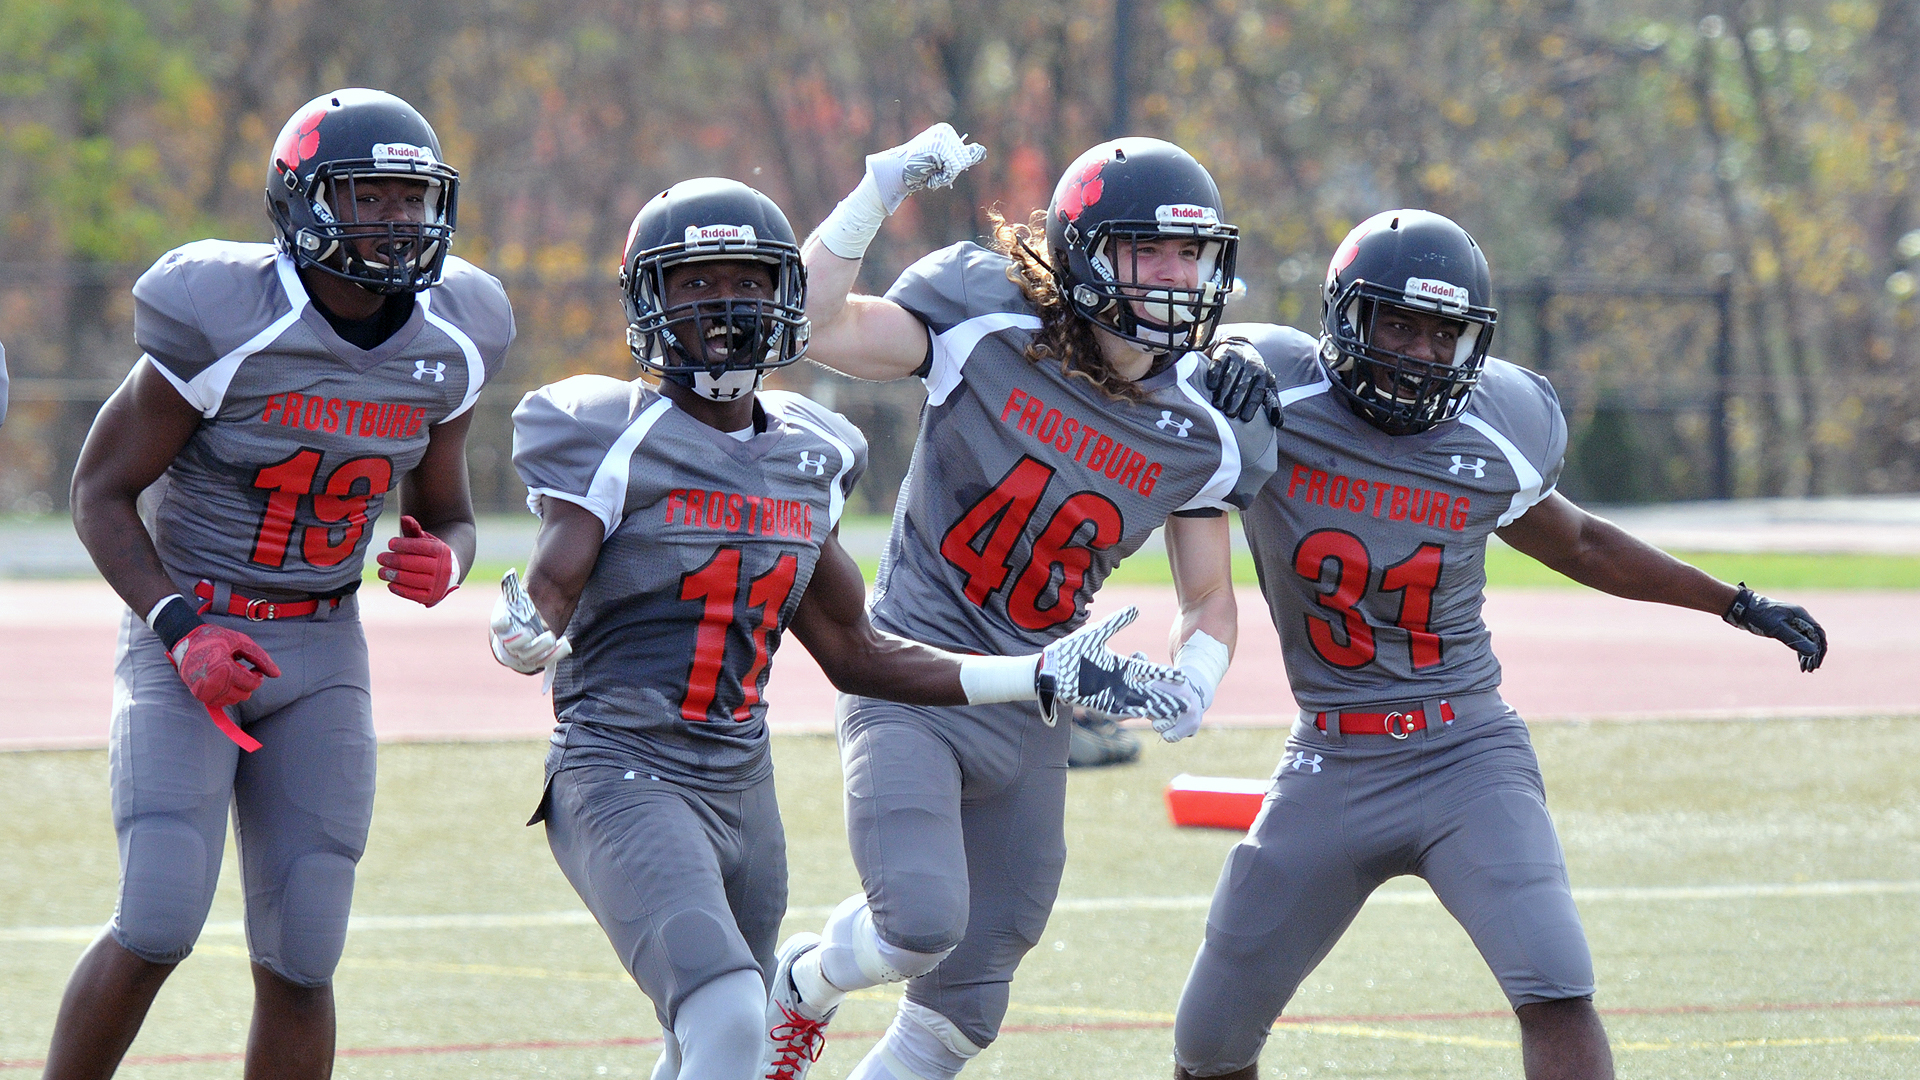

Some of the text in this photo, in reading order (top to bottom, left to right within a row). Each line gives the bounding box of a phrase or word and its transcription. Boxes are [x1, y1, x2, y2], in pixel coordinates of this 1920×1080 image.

[388, 147, 420, 158] Riddell
[701, 228, 739, 239] Riddell
[1172, 207, 1203, 218] Riddell
[1421, 282, 1455, 298] Riddell
[261, 391, 427, 438] FROSTBURG
[1000, 387, 1163, 498] FROSTBURG
[248, 445, 394, 570] 19
[664, 488, 814, 542] FROSTBURG
[1286, 463, 1471, 532] FROSTBURG
[939, 452, 1125, 633] 46
[1291, 527, 1446, 674] 31
[677, 544, 799, 723] 11
